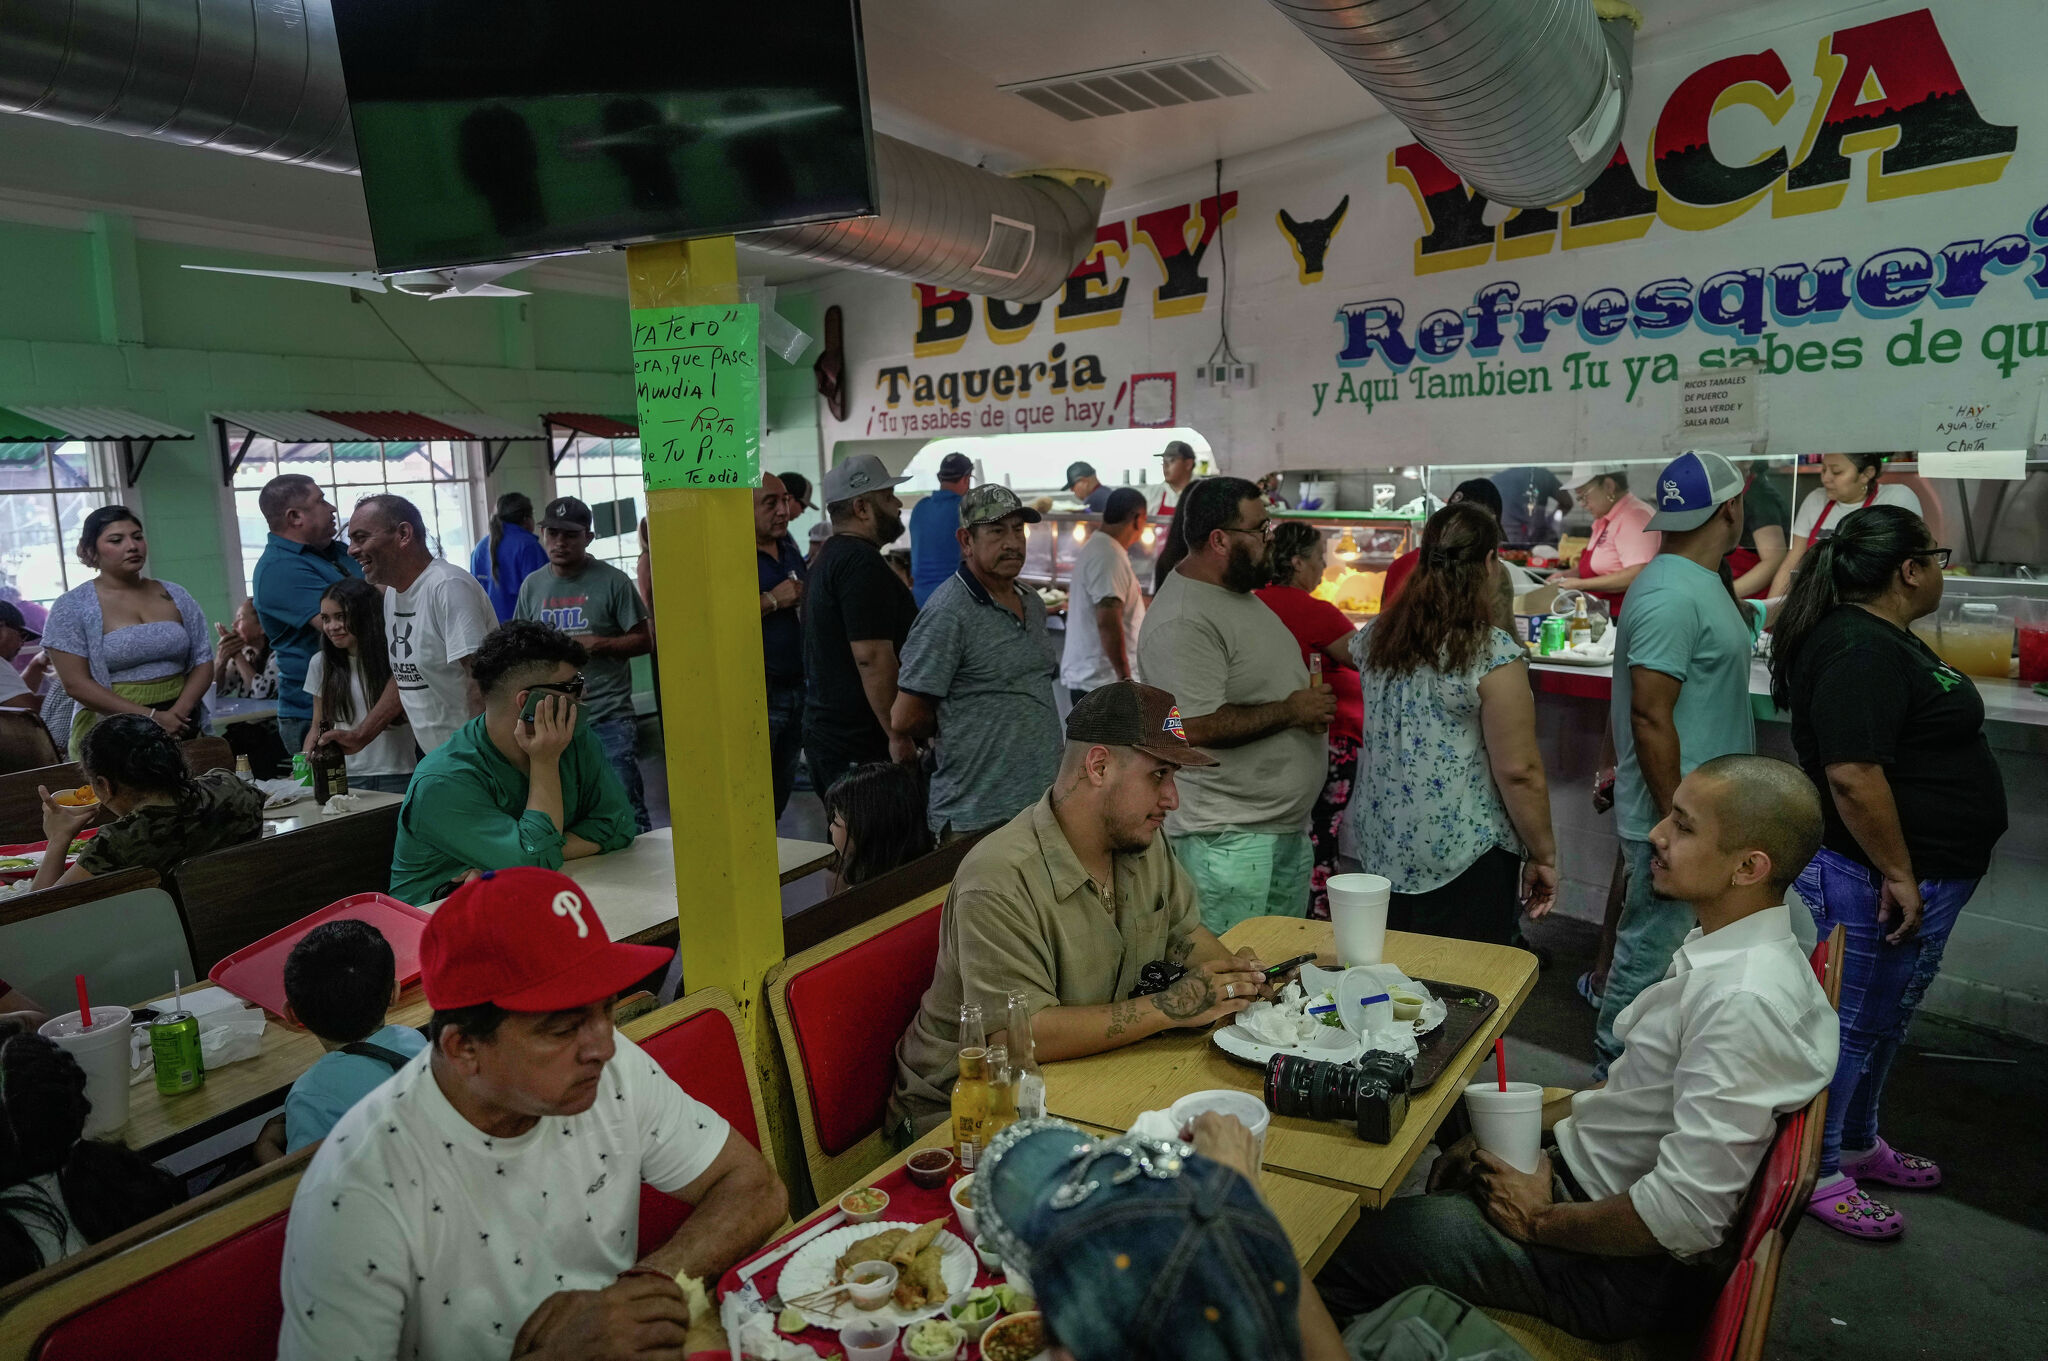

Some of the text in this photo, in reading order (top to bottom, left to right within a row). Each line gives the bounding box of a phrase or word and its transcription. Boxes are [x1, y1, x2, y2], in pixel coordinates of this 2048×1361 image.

[1312, 381, 1329, 417] y
[1408, 362, 1552, 399] Tambien
[1562, 351, 1612, 391] Tu
[1622, 353, 1680, 403] ya
[1699, 333, 1864, 375] sabes
[1886, 318, 1963, 366] de
[1684, 376, 1746, 390] RICOS TAMALES
[1684, 391, 1728, 402] DE PUERCO
[901, 413, 918, 438] ya
[920, 408, 971, 432] sabes
[980, 405, 1004, 427] de
[1015, 405, 1054, 432] que
[1065, 380, 1128, 429] hay!
[1684, 402, 1743, 414] SALSA VERDE Y
[1683, 417, 1730, 427] SALSA ROJA
[552, 890, 588, 938] P
